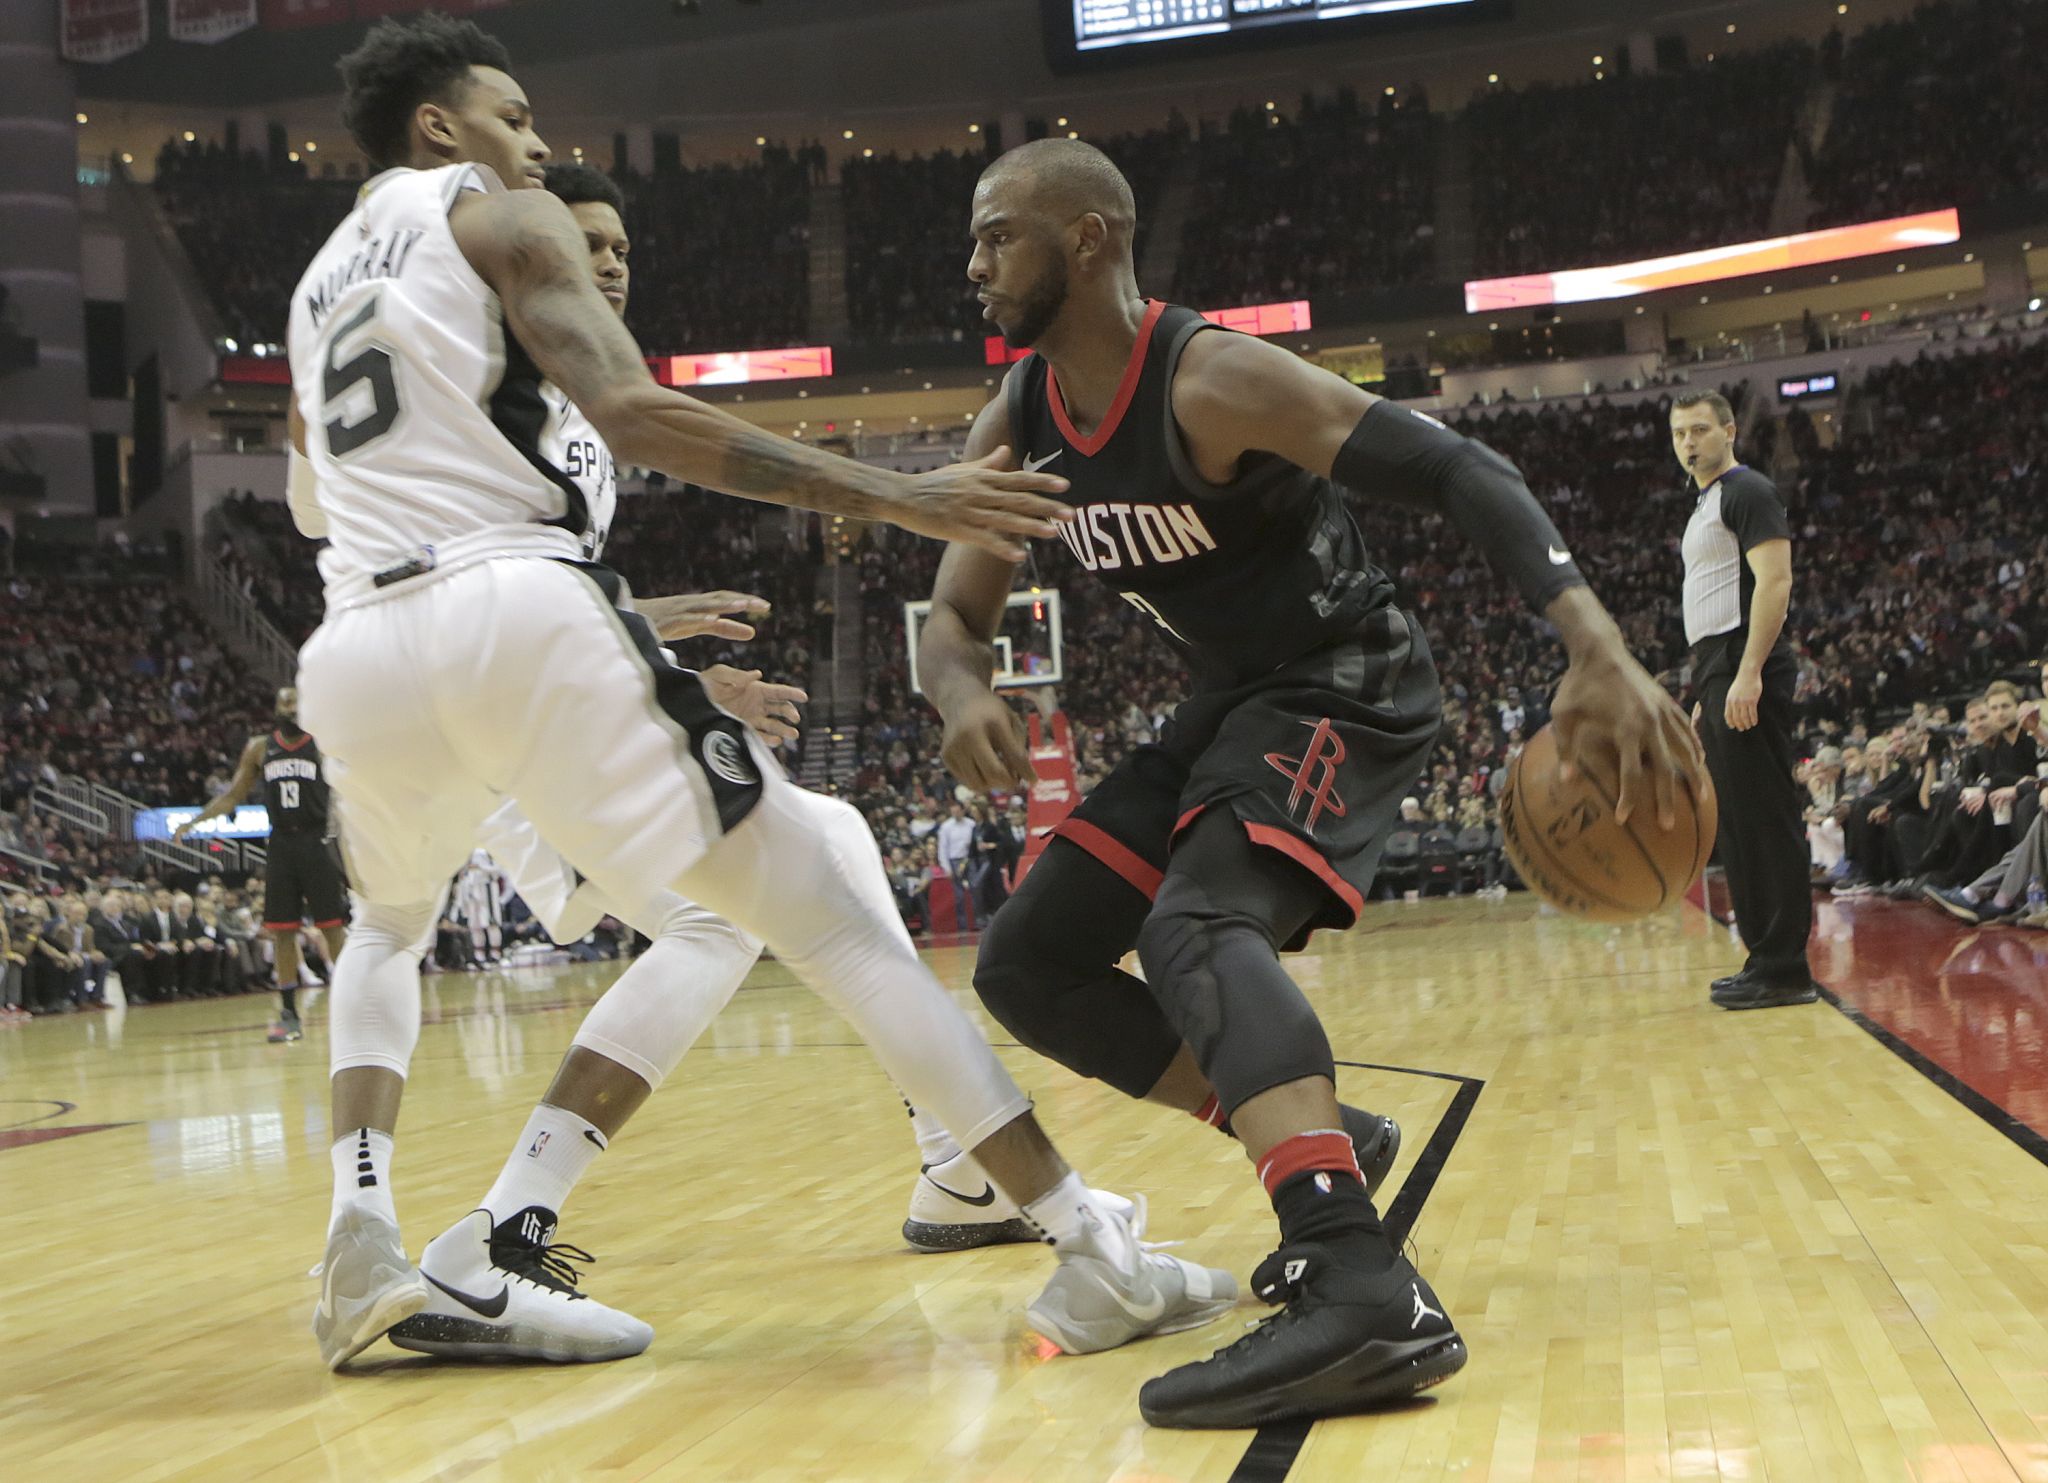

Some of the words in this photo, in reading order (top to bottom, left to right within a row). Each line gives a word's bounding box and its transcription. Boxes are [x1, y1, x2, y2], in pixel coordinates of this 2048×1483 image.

[322, 294, 401, 458] 5
[263, 758, 317, 783] HOUSTON
[278, 780, 300, 809] 13
